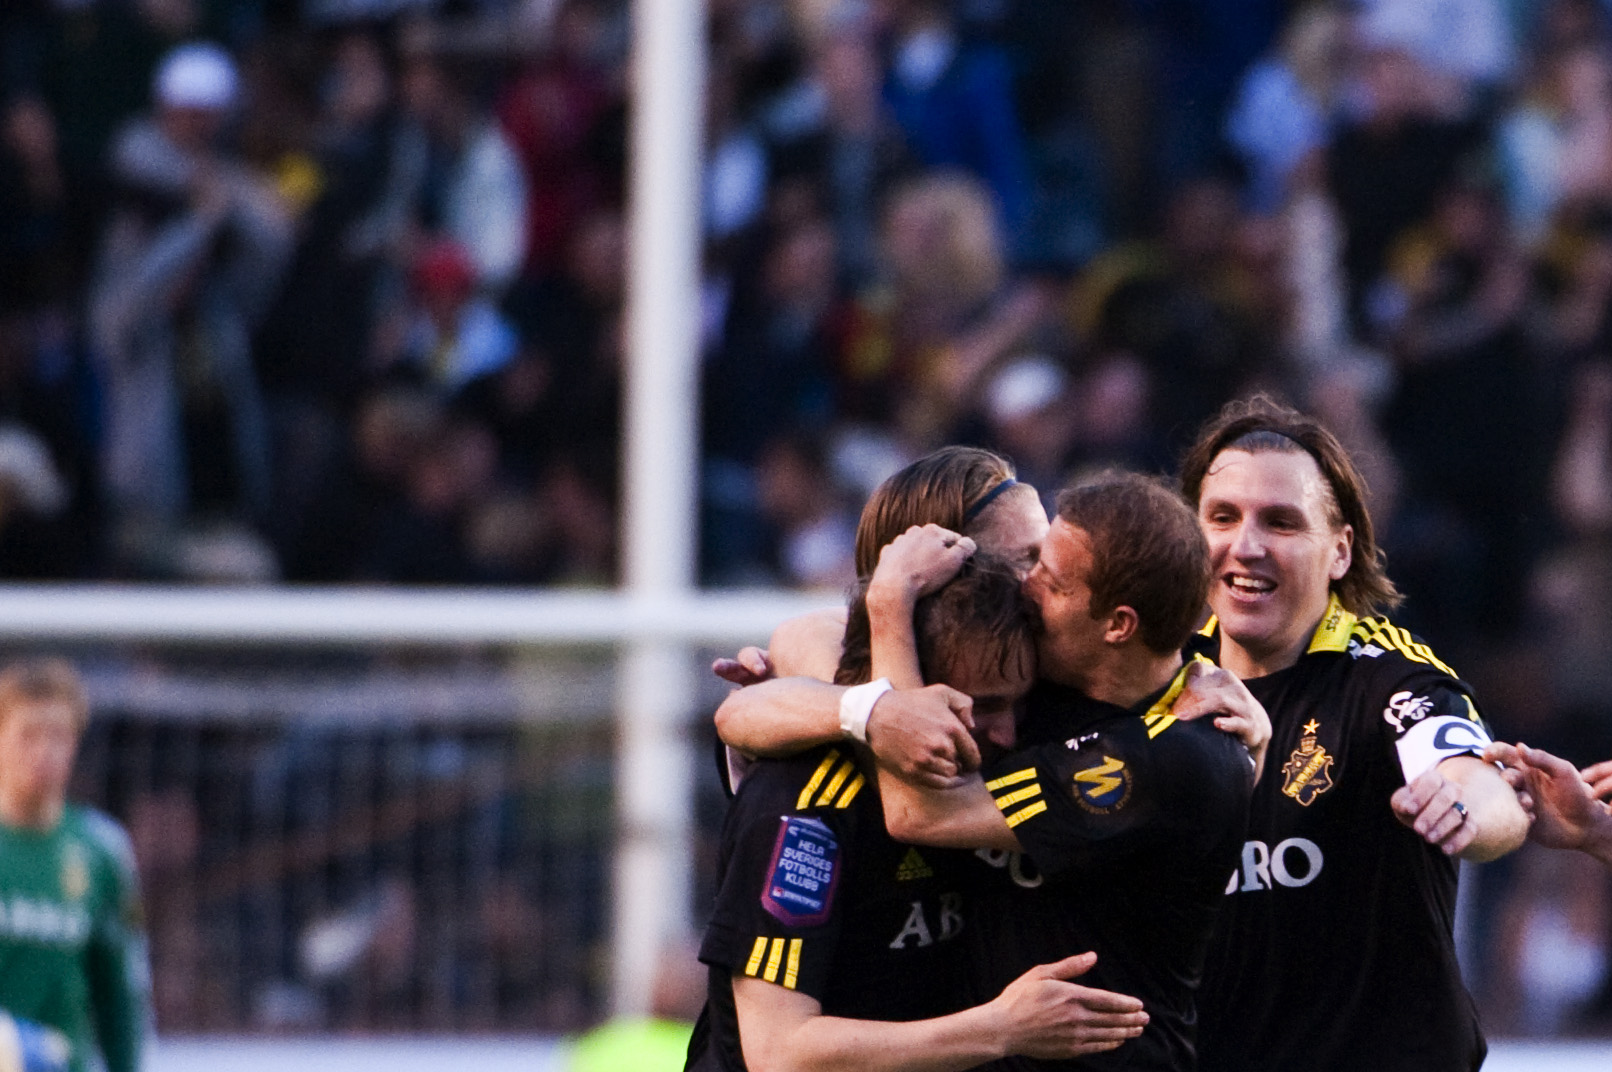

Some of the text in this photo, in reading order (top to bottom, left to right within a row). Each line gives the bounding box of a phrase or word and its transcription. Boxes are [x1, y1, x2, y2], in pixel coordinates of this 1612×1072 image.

[783, 846, 833, 872] SVERIGES
[798, 839, 825, 857] HELA
[779, 858, 831, 884] FOTBOLLS
[785, 872, 819, 892] KLUBB
